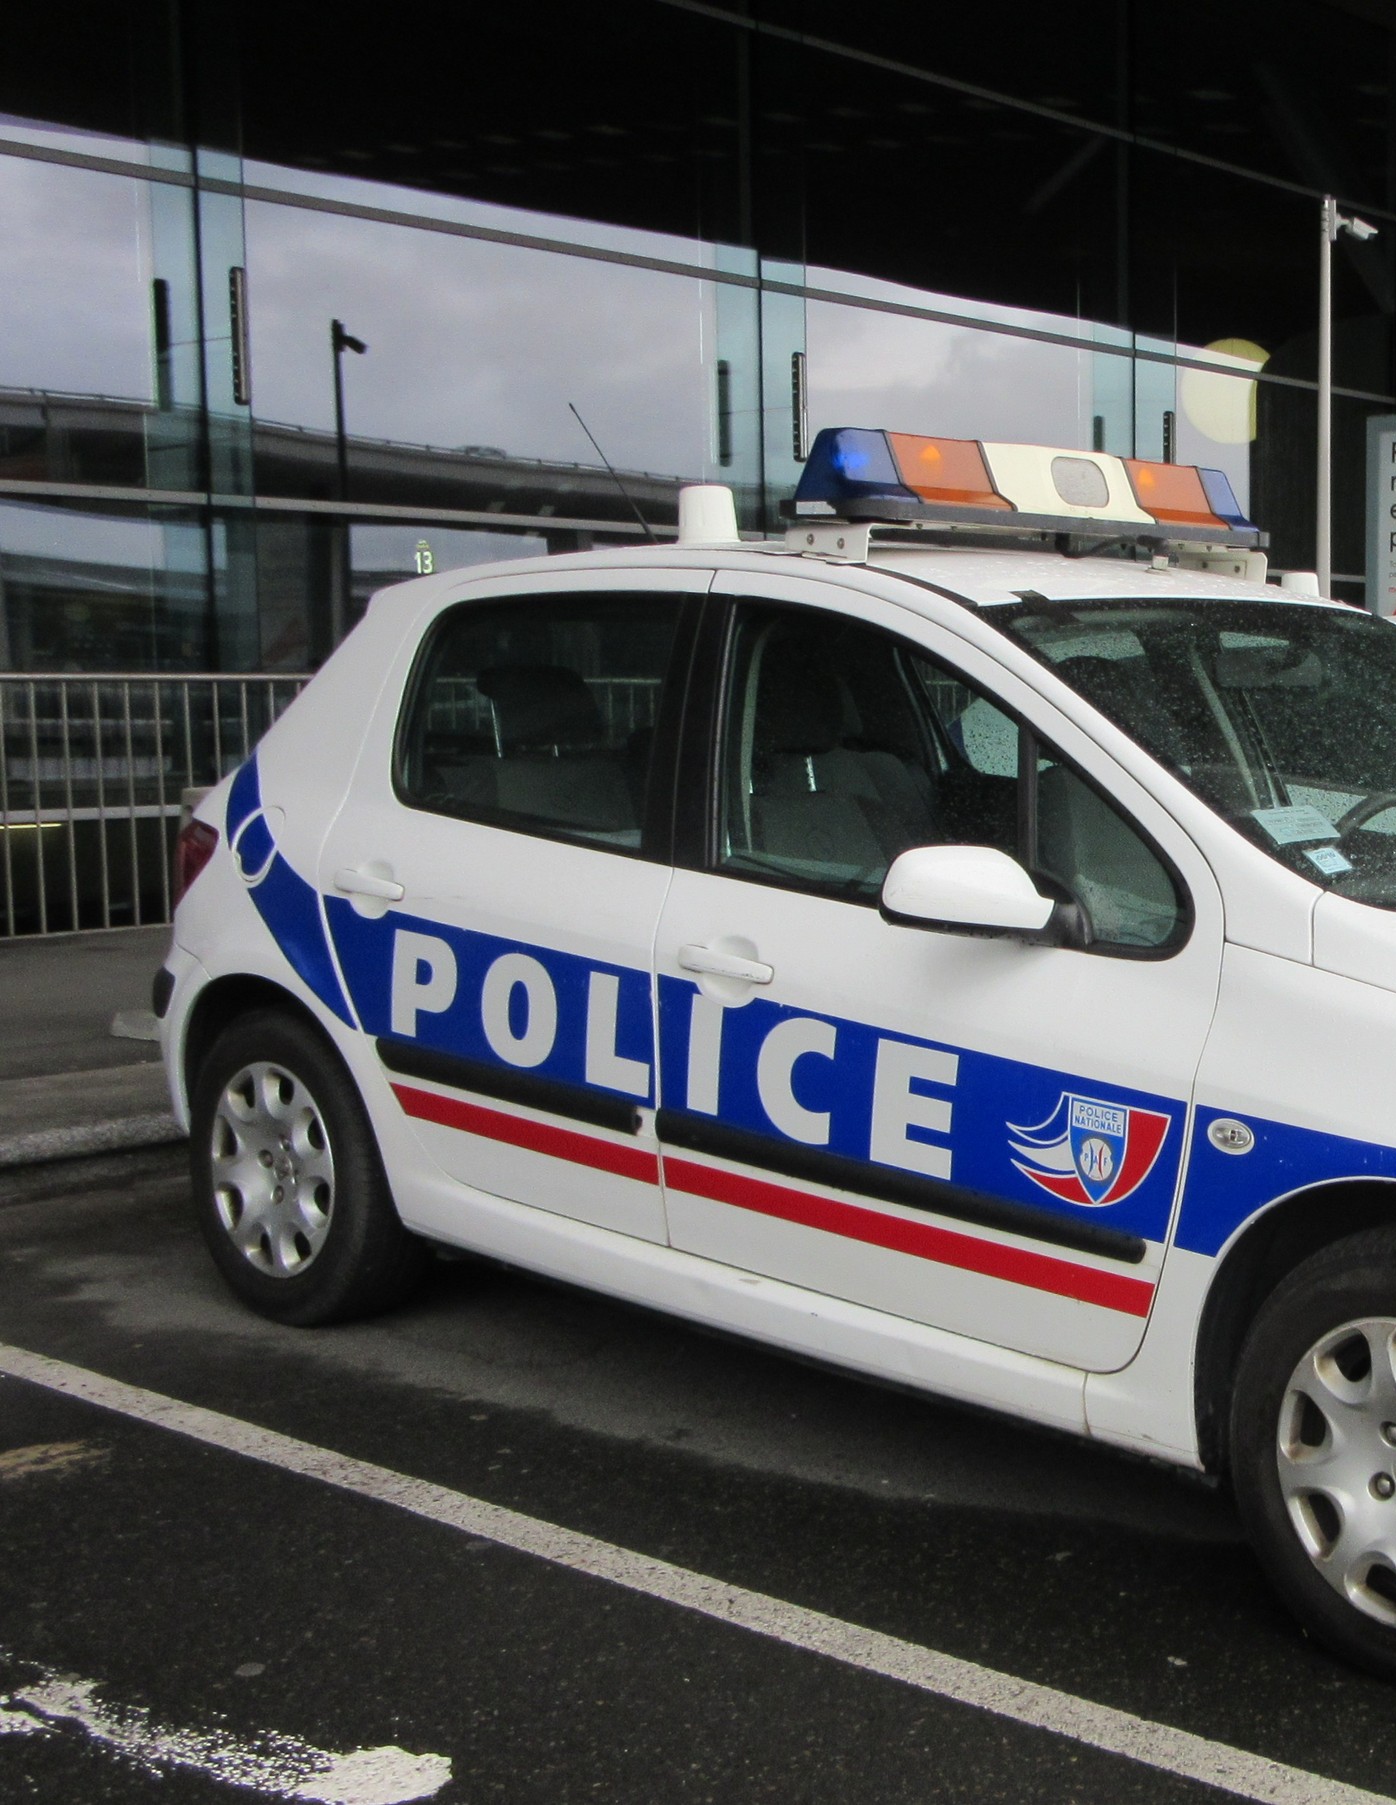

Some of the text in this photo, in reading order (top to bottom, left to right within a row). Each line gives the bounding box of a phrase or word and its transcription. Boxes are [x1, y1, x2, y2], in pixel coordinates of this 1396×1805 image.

[414, 550, 434, 574] 13
[391, 929, 960, 1181] POLICE
[1079, 1105, 1118, 1122] POLICE
[1074, 1115, 1122, 1134] NATIONALE
